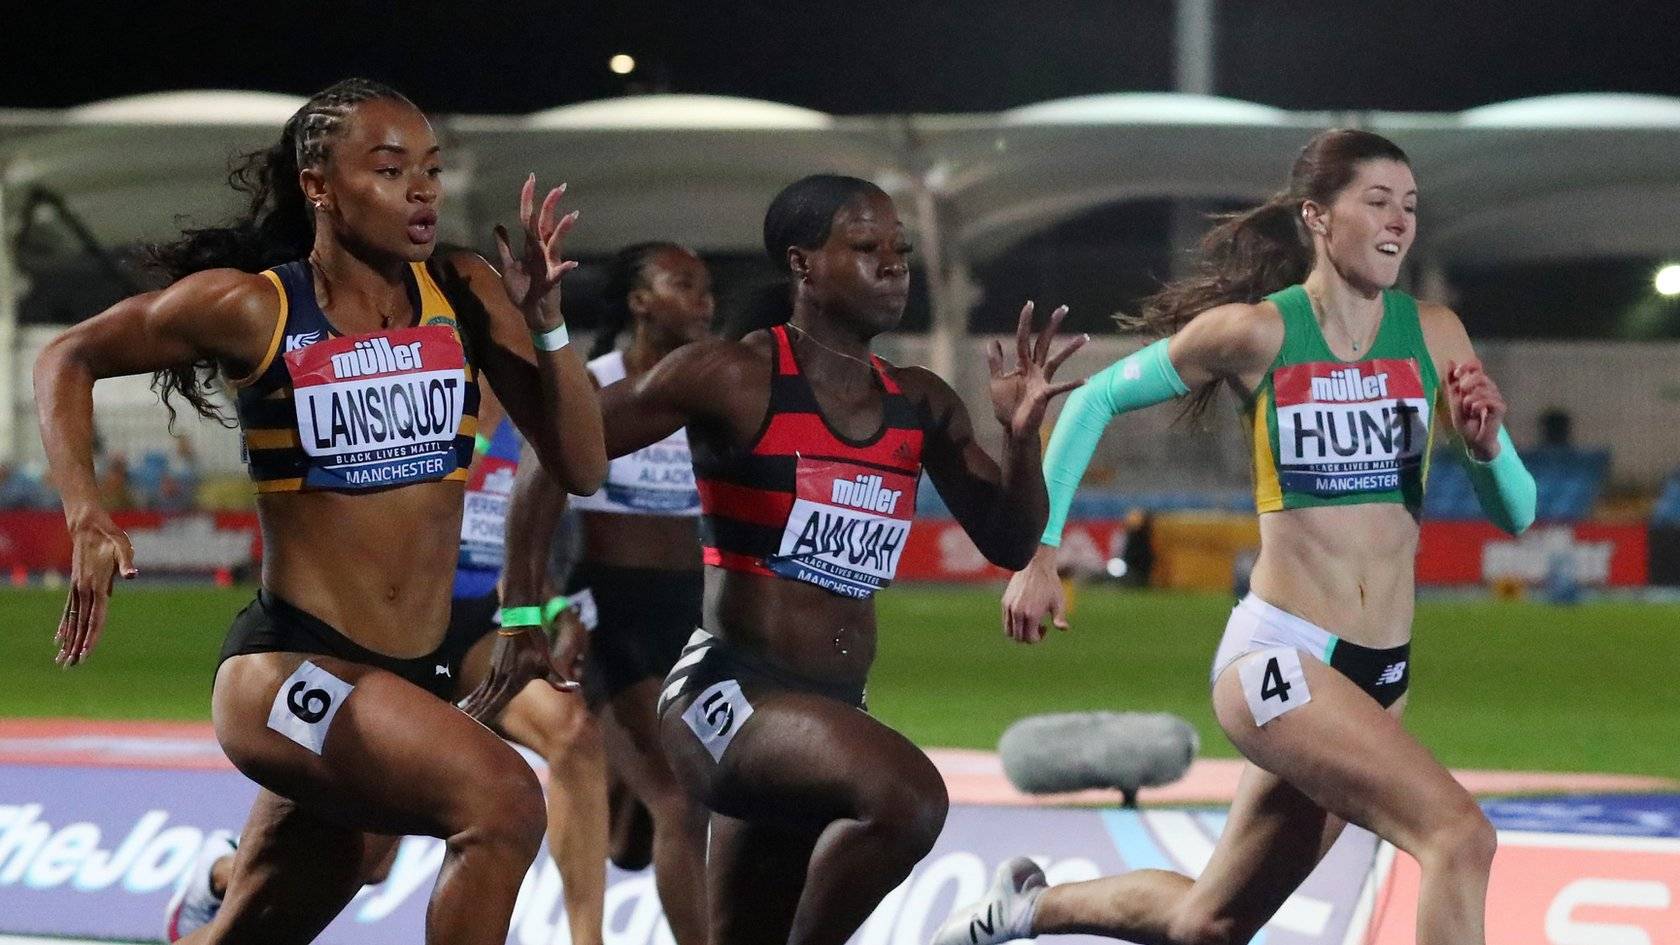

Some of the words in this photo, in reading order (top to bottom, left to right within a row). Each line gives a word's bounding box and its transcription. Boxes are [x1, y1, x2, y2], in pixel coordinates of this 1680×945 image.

[331, 336, 423, 379] müller
[1311, 368, 1388, 401] müller
[309, 378, 458, 449] LANSIQUOT
[1293, 406, 1418, 458] HUNT
[336, 452, 372, 464] BLACK
[377, 447, 407, 459] LIVES
[346, 458, 444, 484] MANCHESTER
[1344, 461, 1369, 471] LIVES
[831, 474, 902, 514] müller
[1316, 474, 1399, 490] MANCHESTER
[791, 511, 905, 572] AWUAH
[799, 556, 827, 570] LACK
[830, 565, 852, 578] LIVES
[1260, 657, 1292, 703] 4
[287, 680, 332, 724] 6
[702, 690, 735, 737] 5
